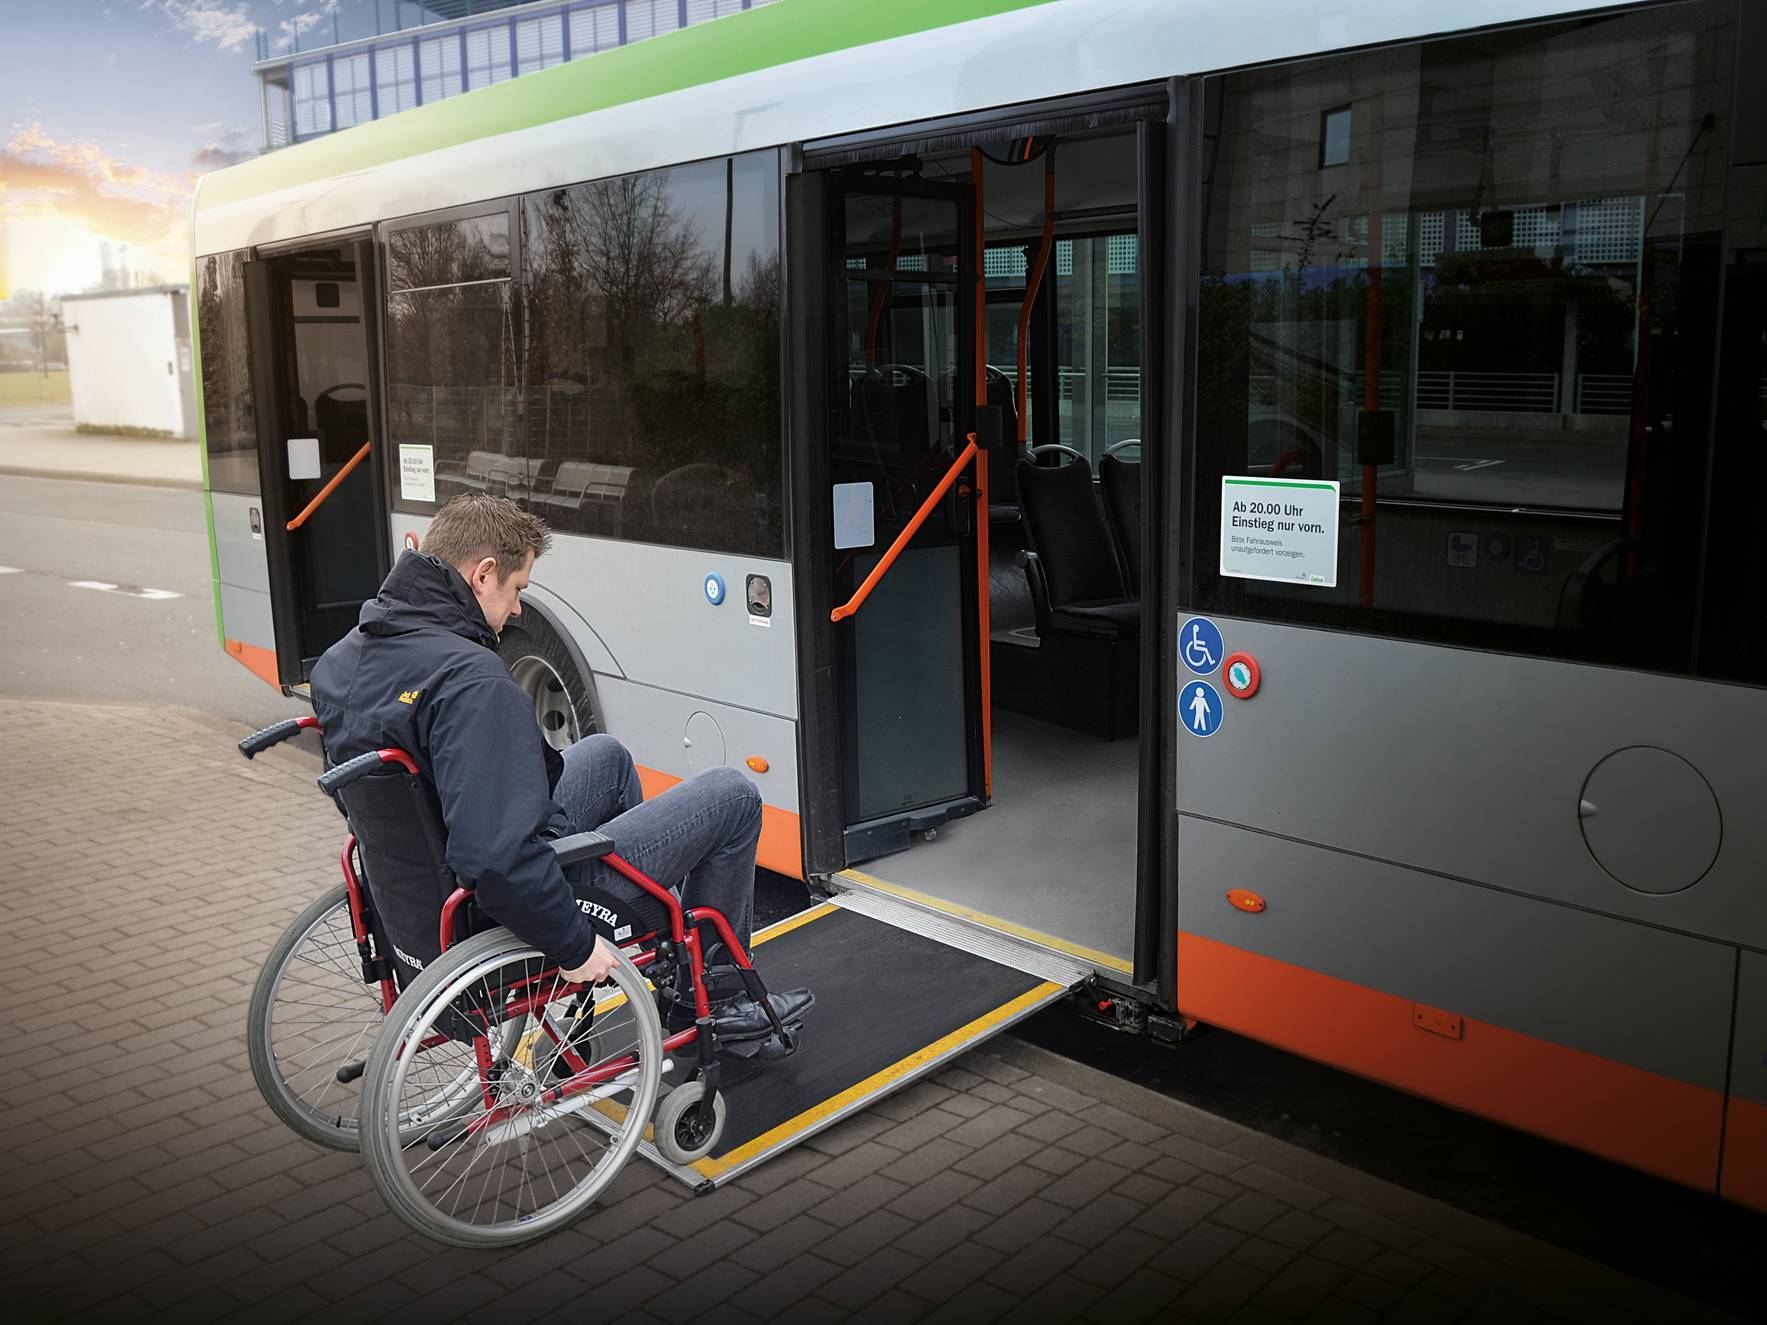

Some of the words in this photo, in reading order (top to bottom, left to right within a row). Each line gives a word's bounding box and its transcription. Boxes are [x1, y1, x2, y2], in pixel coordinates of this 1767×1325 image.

[1232, 501, 1247, 513] Ab
[1249, 502, 1281, 515] 20.00
[1284, 504, 1304, 517] Uhr
[1231, 516, 1275, 532] Einstieg
[1277, 521, 1295, 532] nur
[1298, 523, 1325, 534] vorn.
[1231, 535, 1246, 544] Bitte
[1246, 536, 1283, 547] Fahrausweis
[1231, 545, 1274, 556] unaufgefordert
[575, 898, 618, 928] EYRA
